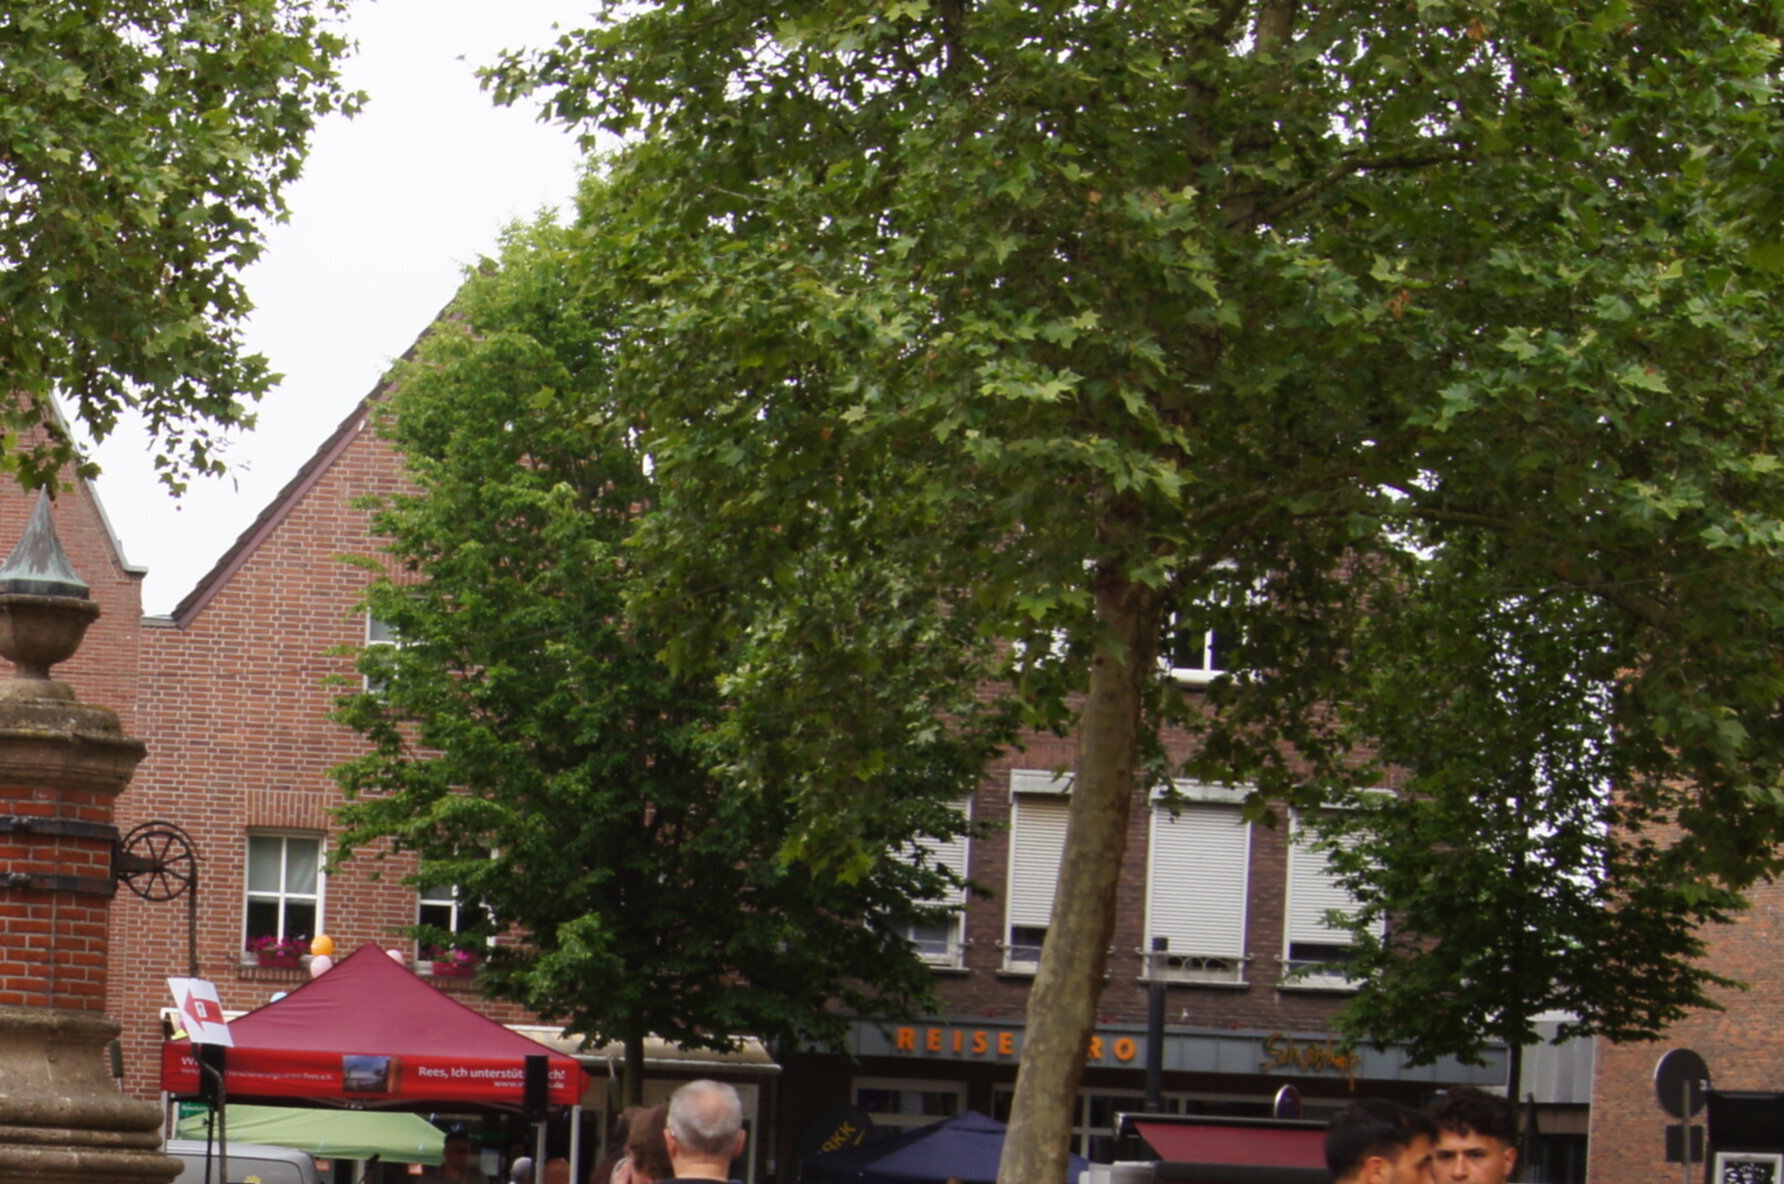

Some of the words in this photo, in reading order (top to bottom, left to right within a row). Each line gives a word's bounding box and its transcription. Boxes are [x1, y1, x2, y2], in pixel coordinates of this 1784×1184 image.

[896, 1027, 1137, 1061] REISERO
[418, 1066, 449, 1079] Rees,
[451, 1067, 467, 1078] Ich
[470, 1068, 525, 1079] unterstüt
